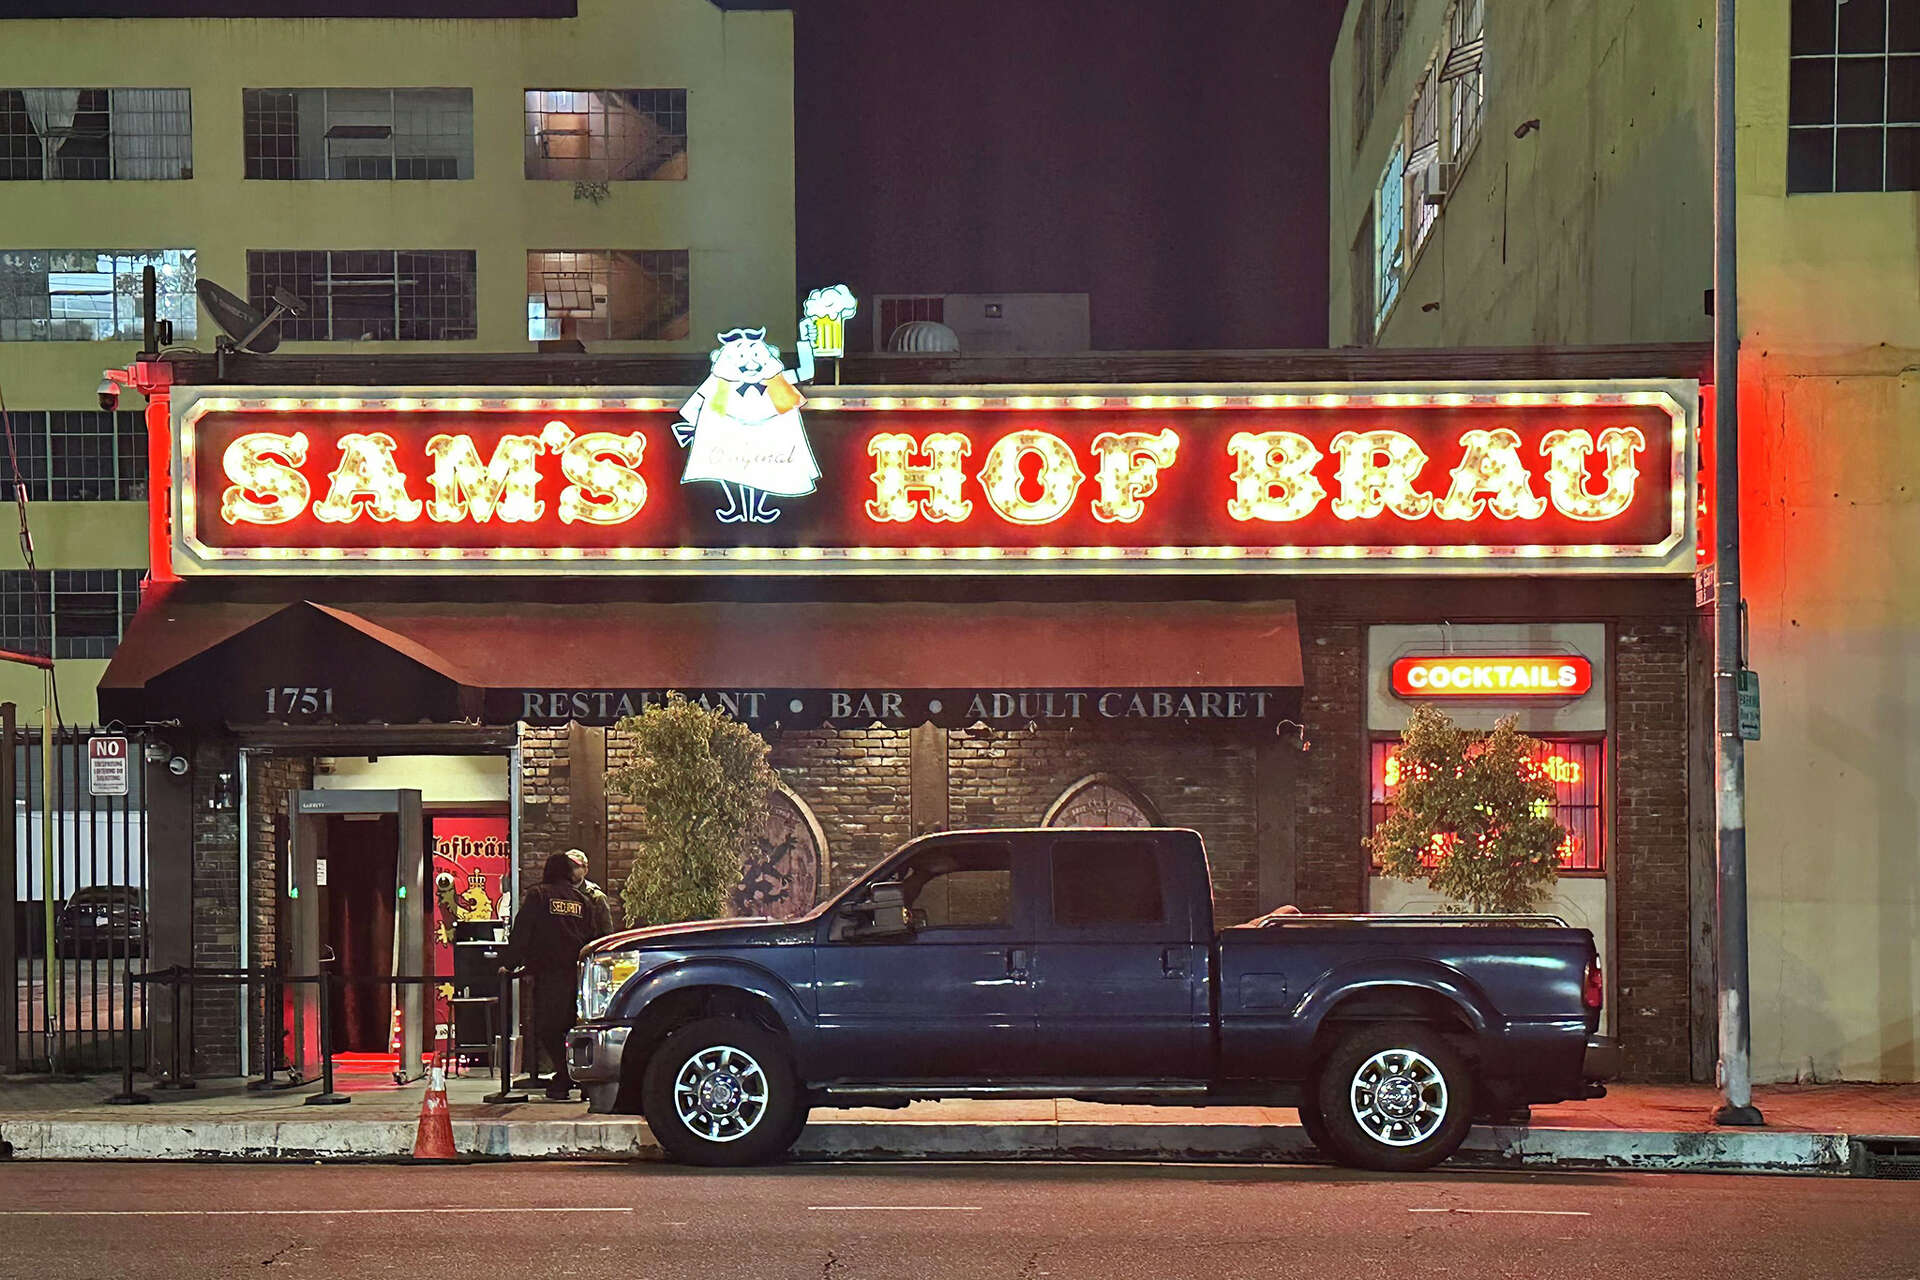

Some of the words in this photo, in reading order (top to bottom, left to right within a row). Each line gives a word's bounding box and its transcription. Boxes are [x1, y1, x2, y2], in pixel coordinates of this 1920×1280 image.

[220, 420, 648, 525] SAM'S
[865, 428, 1181, 525] HOF
[1227, 427, 1646, 522] BRAU
[1407, 665, 1577, 689] COCKTAILS
[265, 687, 333, 714] 1751
[521, 691, 767, 718] RESTAUANT
[831, 691, 905, 719] BAR
[965, 692, 1088, 719] ADULT
[1099, 691, 1273, 718] CABARET
[96, 740, 120, 757] NO
